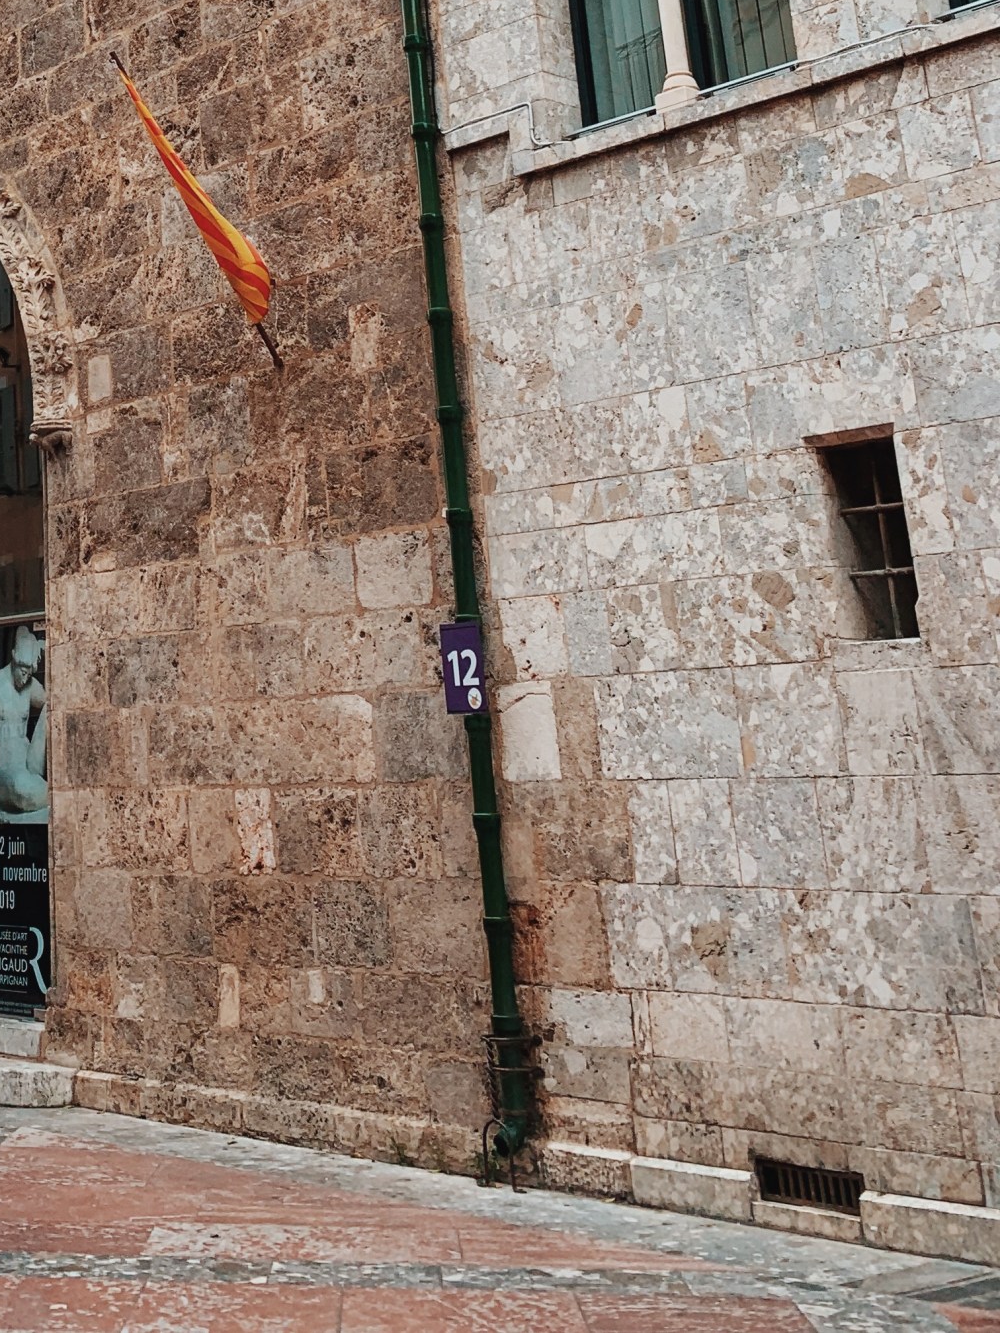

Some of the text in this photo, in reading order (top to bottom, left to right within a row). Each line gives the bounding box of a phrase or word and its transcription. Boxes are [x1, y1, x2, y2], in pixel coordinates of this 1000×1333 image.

[446, 648, 480, 687] 12
[8, 836, 25, 860] juin
[3, 862, 47, 883] novembre
